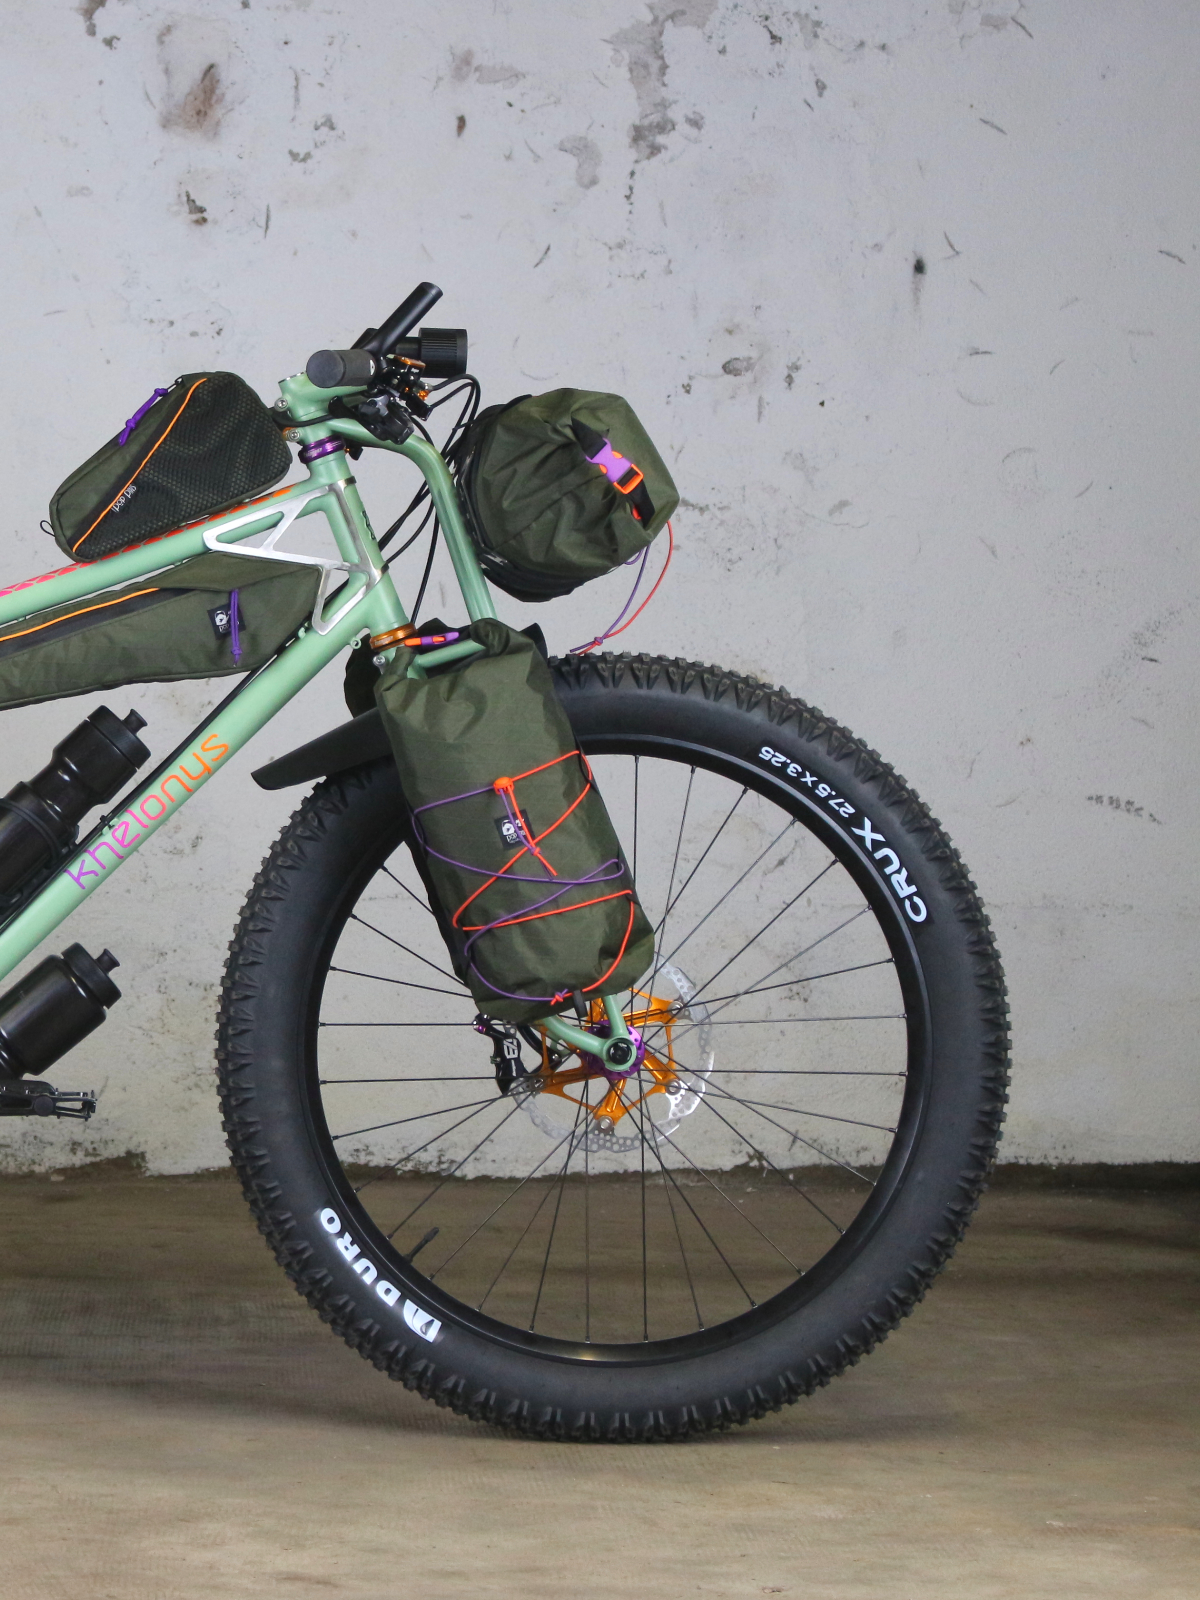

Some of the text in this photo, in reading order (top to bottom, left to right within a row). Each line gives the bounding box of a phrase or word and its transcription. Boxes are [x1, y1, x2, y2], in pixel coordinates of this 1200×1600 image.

[64, 733, 229, 890] khelonus
[851, 816, 927, 923] CRUX
[319, 1207, 402, 1307] DURO
